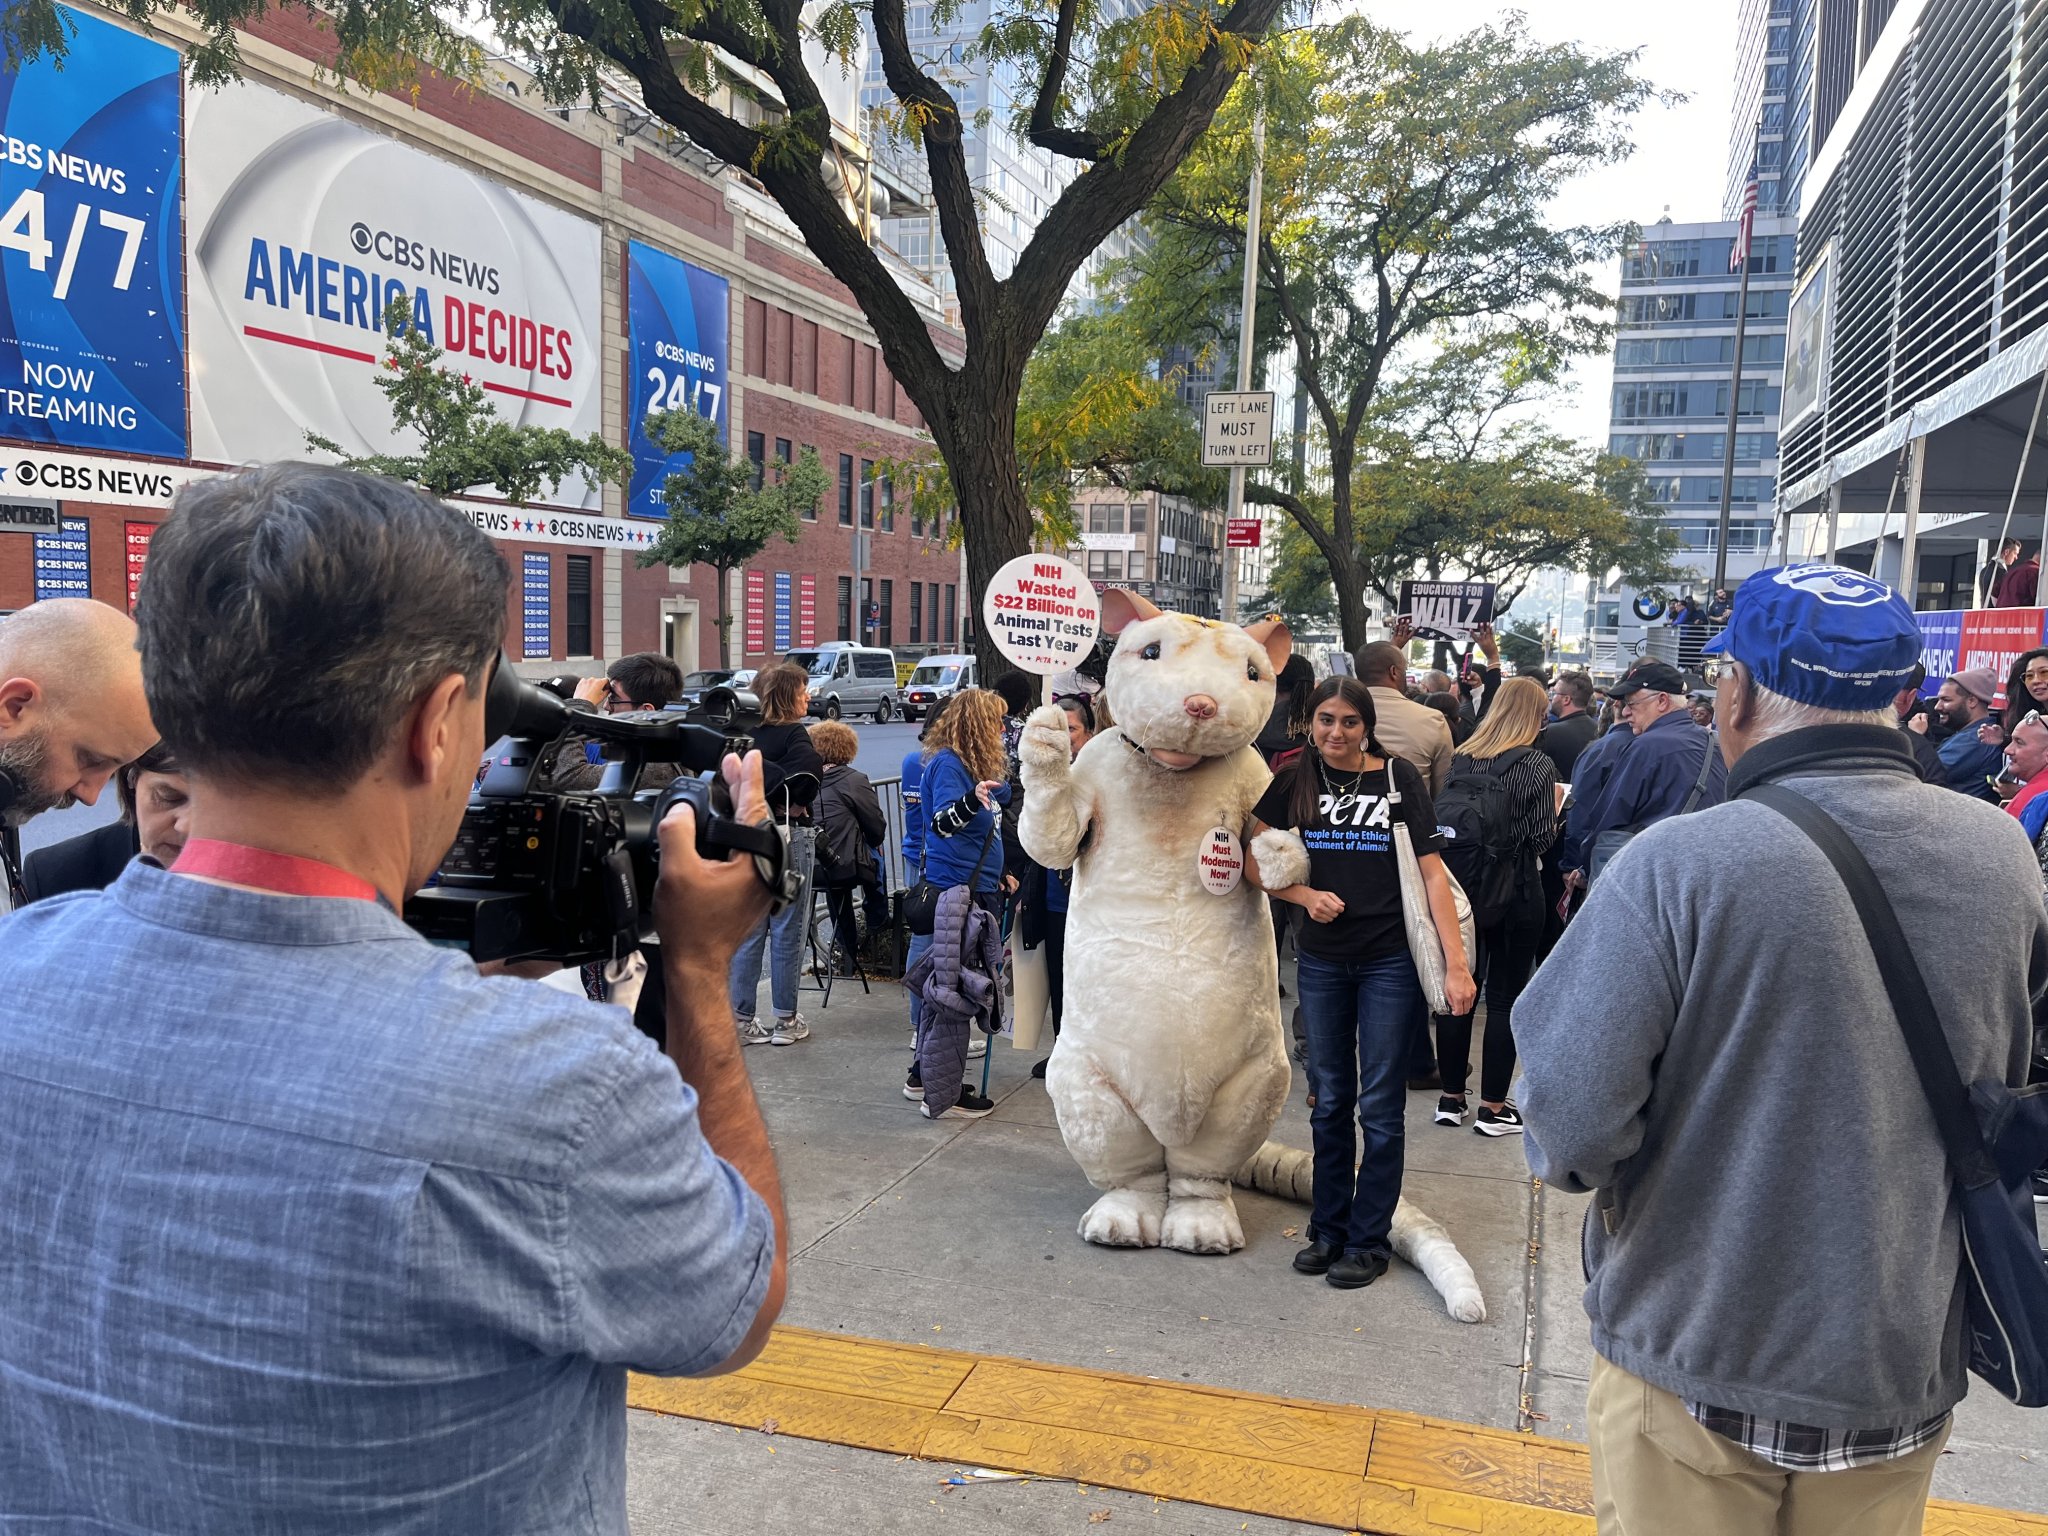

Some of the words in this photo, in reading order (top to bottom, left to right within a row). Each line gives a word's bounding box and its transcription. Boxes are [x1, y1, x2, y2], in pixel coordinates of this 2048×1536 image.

[48, 149, 127, 195] NEWS
[374, 230, 425, 271] CBS
[430, 247, 500, 295] NEWS
[244, 237, 435, 347] AMERICA
[444, 294, 572, 381] DECIDES
[2, 337, 19, 345] LIVE
[664, 344, 685, 363] CBS
[686, 352, 715, 373] NEWS
[23, 359, 95, 393] NOW
[647, 367, 722, 424] 24/7
[1211, 402, 1236, 414] LEFT
[1241, 401, 1268, 414] LANE
[1220, 422, 1256, 436] MUST
[1209, 445, 1236, 456] TURN
[1241, 444, 1266, 456] LEFT
[40, 463, 93, 491] CBS
[98, 468, 174, 498] NEWS
[62, 522, 86, 531] NEWS
[559, 520, 585, 539] CBS
[586, 523, 625, 542] NEWS
[44, 540, 61, 550] CBS
[62, 541, 87, 550] NEWS
[45, 560, 61, 570] CBS
[62, 561, 87, 570] NEWS
[1034, 564, 1062, 579] NIH
[46, 580, 62, 589] CBS
[63, 580, 87, 589] NEWS
[1017, 579, 1076, 600] Wasted
[1411, 583, 1463, 596] EDUCATORS
[1465, 586, 1484, 597] FOR
[993, 593, 1023, 609] $22
[1027, 598, 1074, 616] Billion
[1077, 608, 1095, 620] on
[1411, 597, 1482, 629] WALZ
[994, 612, 1050, 631] Animal
[1054, 620, 1093, 638] Tests
[1007, 632, 1041, 648] Last
[1045, 635, 1078, 653] Year
[1215, 832, 1229, 843] NIH
[1304, 829, 1330, 841] People
[1332, 830, 1344, 840] for
[1346, 830, 1360, 840] the
[1361, 831, 1390, 842] Ethical
[1212, 844, 1231, 855] Must
[1346, 840, 1355, 850] of
[1356, 841, 1389, 852] Animals
[1201, 855, 1241, 869] Modernize
[1210, 869, 1230, 880] Now!
